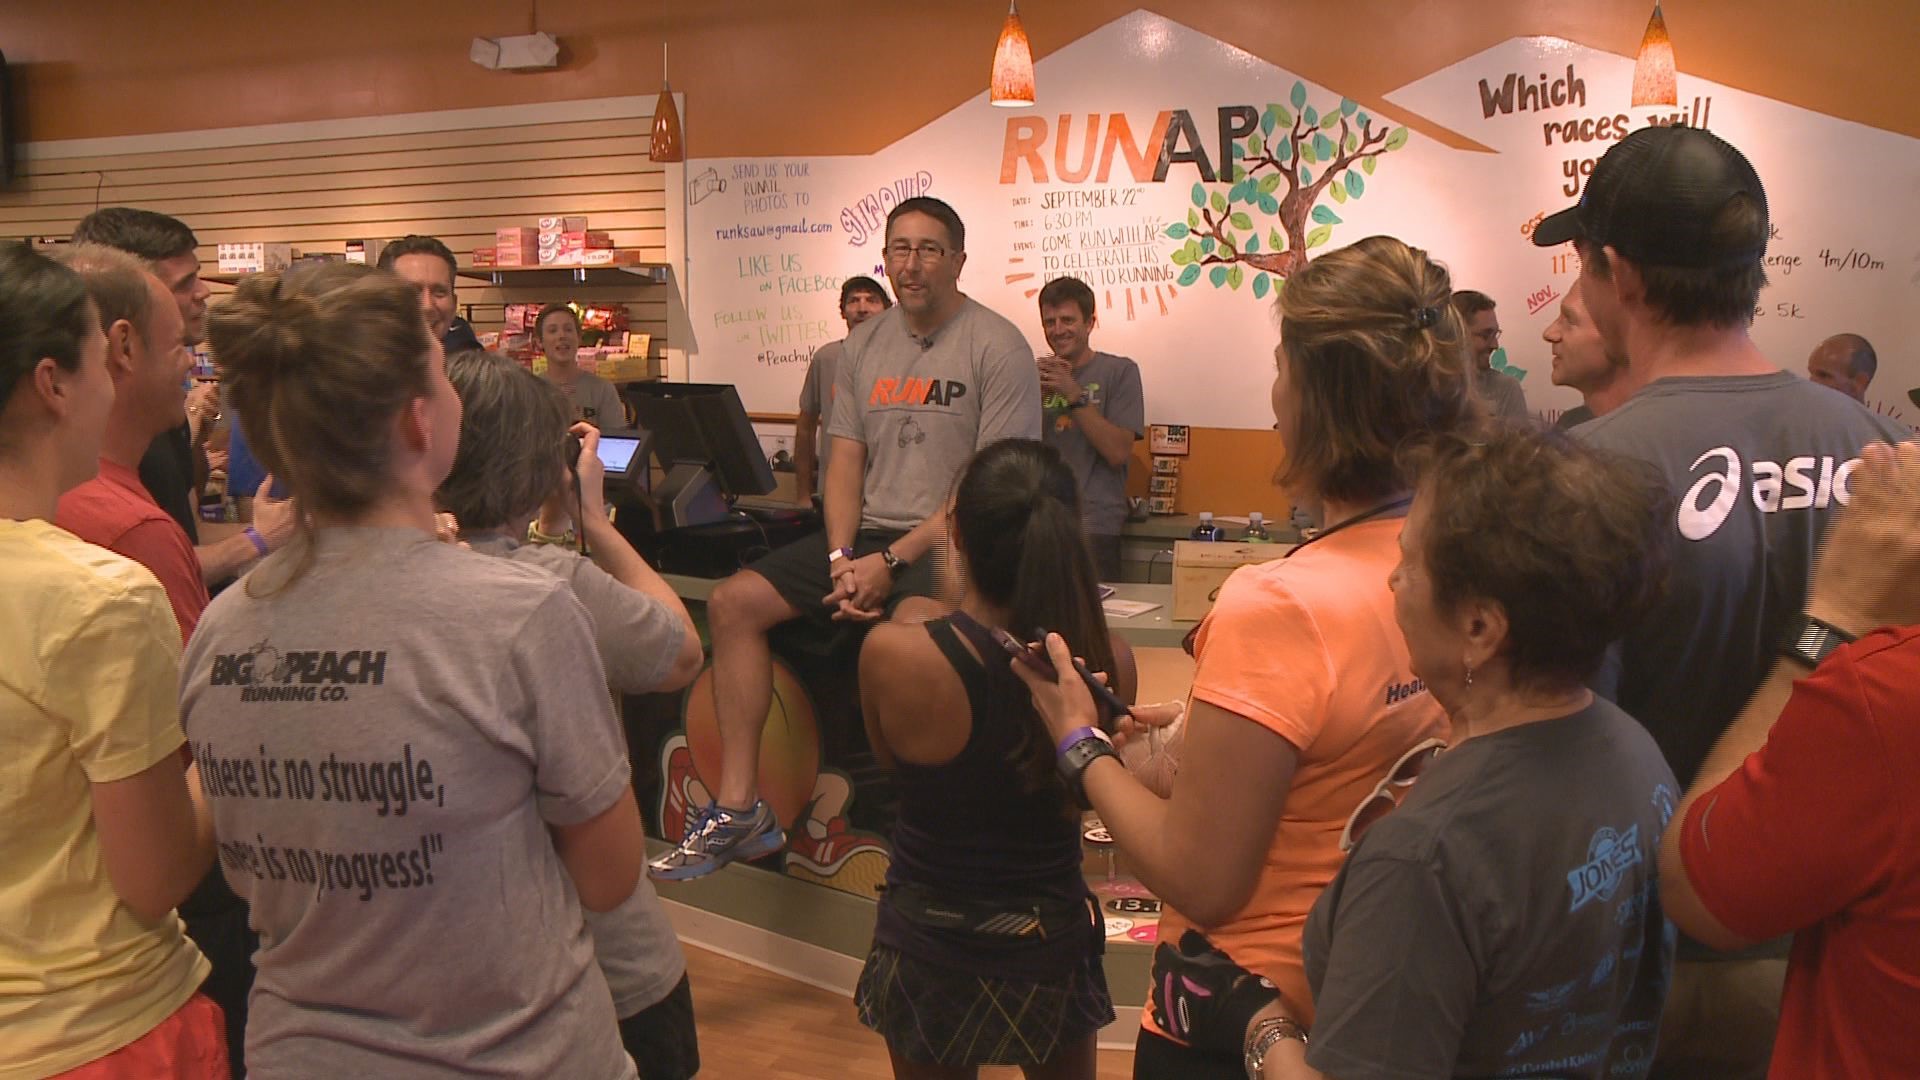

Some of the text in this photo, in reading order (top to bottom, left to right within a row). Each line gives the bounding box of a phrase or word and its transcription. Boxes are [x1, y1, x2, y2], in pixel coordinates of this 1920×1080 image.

[1478, 64, 1586, 119] Which
[1543, 113, 1630, 146] races
[999, 105, 1259, 184] RUNAP
[732, 162, 811, 180] SEND US YOUR
[1563, 157, 1600, 197] yo
[744, 192, 810, 216] PHOTOS TO
[1040, 189, 1119, 210] SEPTEMBER
[716, 218, 833, 240] runksaw@gmail.com
[1075, 210, 1093, 228] PM
[1042, 232, 1073, 252] COME
[1080, 228, 1106, 248] RUN
[1109, 226, 1142, 246] WITH
[1144, 223, 1160, 244] AP
[738, 253, 802, 278] LIKE US
[1042, 245, 1160, 270] TO CELEBRATE HIS
[1818, 248, 1885, 271] 4m/10m
[778, 274, 849, 296] FACEBOO
[1101, 269, 1116, 286] TO
[1119, 263, 1174, 284] RUNNING
[714, 305, 803, 328] FOLLOW US
[759, 320, 832, 347] TWITTER
[869, 376, 967, 407] RUNAP
[1751, 455, 1864, 513] asic
[210, 650, 387, 686] BIG PEACH
[240, 686, 349, 703] RUNNING CO.
[259, 743, 282, 799] is
[283, 758, 315, 801] no
[319, 743, 444, 817] struggle,
[256, 833, 287, 881] is
[284, 847, 317, 884] no
[1574, 832, 1637, 905] JONES
